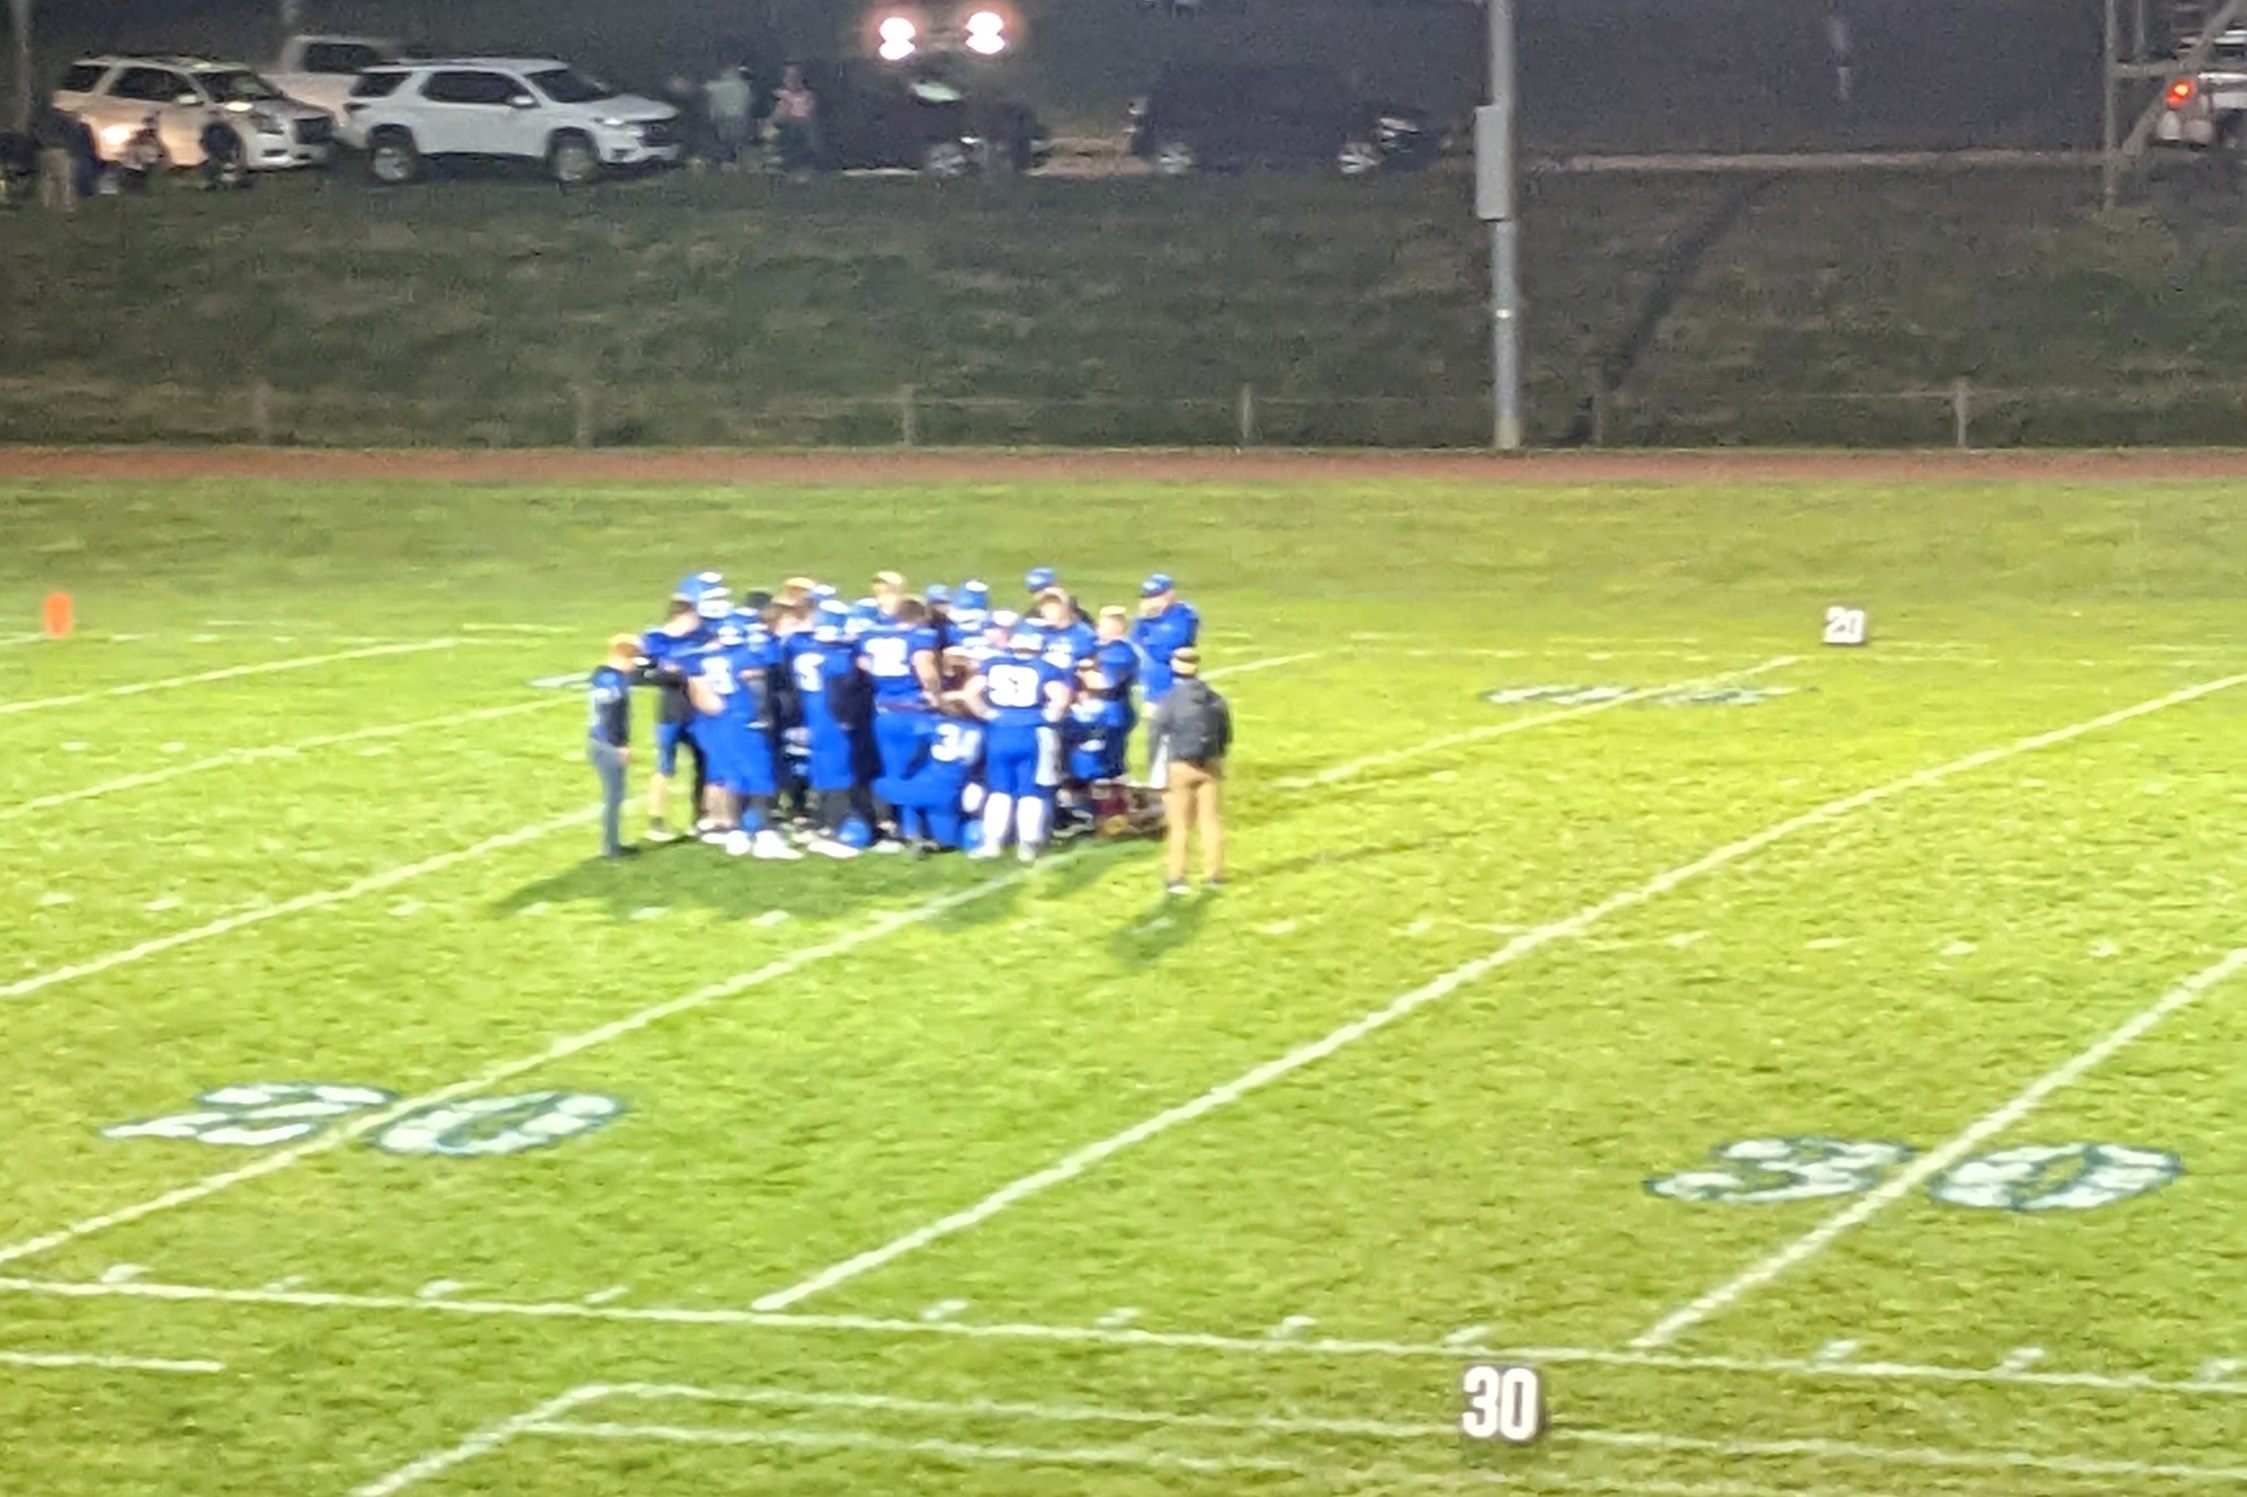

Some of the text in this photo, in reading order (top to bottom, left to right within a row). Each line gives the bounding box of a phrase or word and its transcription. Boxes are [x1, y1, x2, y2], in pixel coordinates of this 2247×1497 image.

[1823, 605, 1864, 644] 20
[1644, 1135, 2184, 1211] 30
[1462, 1365, 1538, 1441] 30
